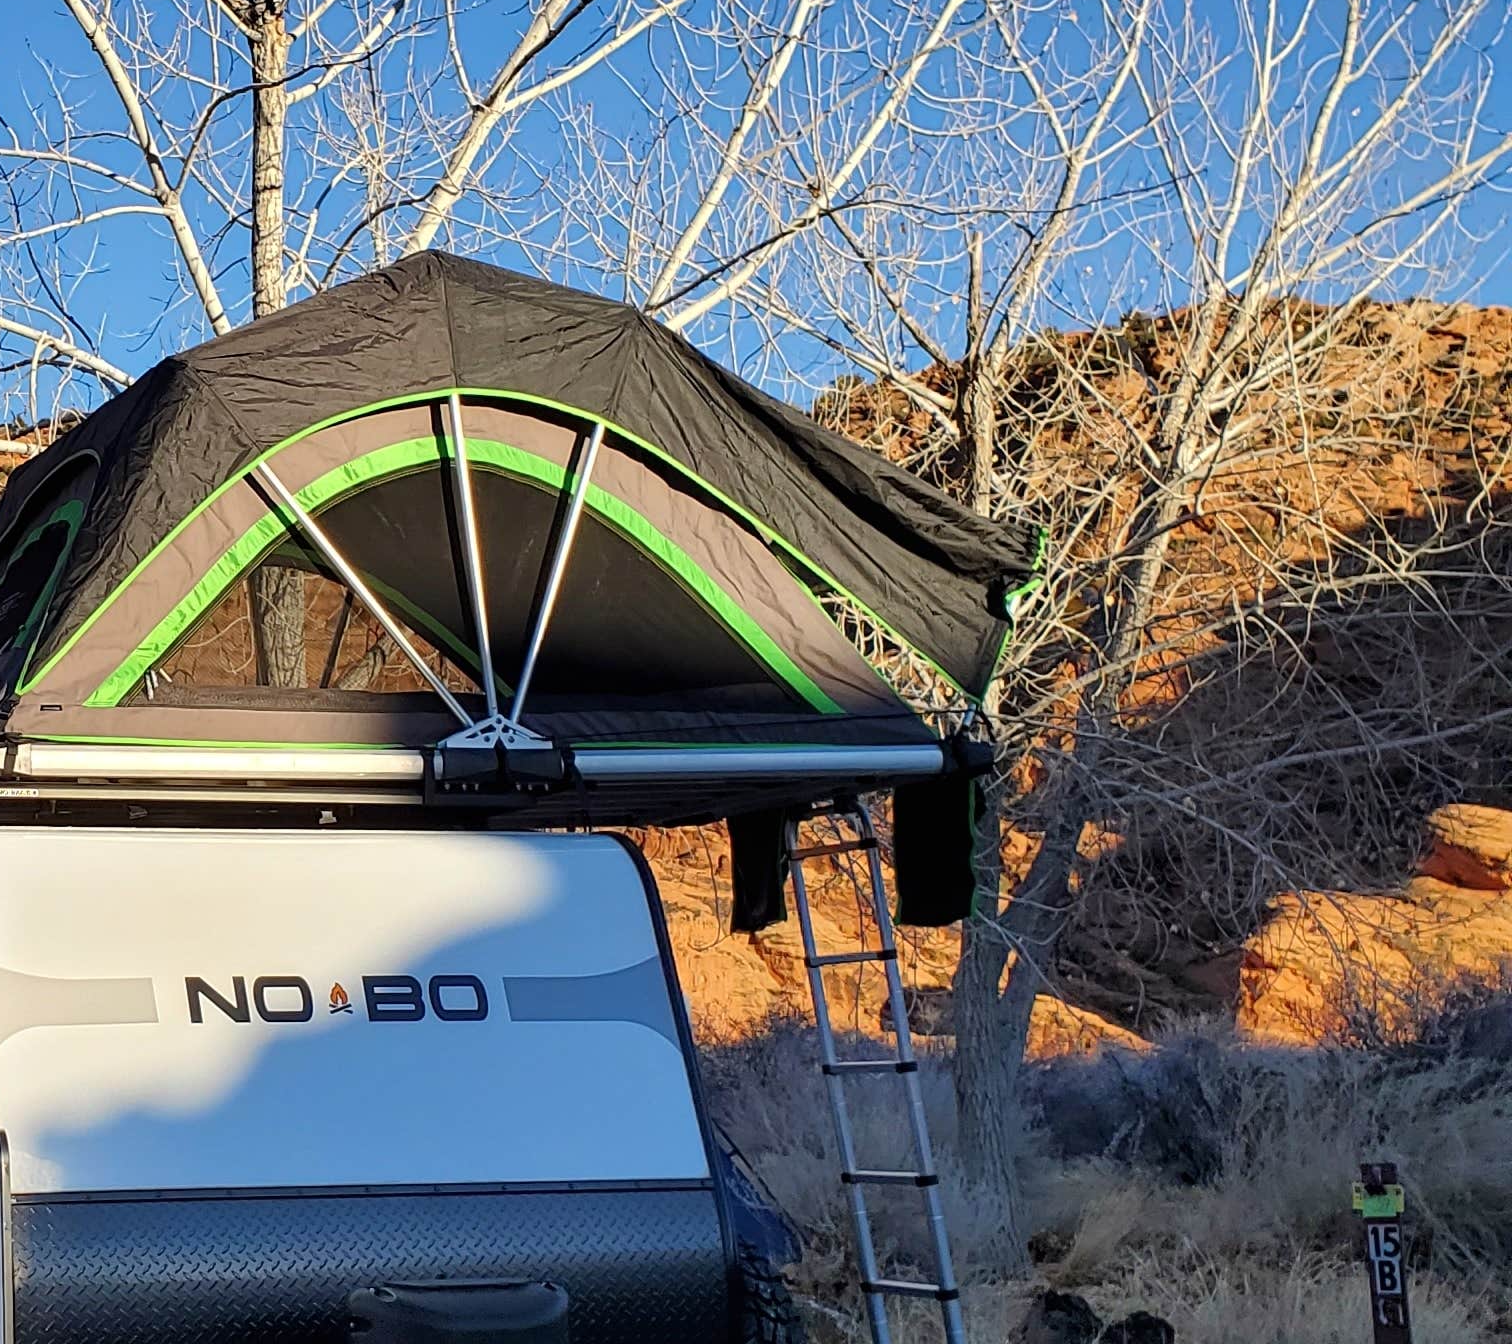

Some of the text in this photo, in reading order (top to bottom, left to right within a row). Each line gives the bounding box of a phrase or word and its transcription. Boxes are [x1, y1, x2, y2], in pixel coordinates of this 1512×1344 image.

[185, 974, 489, 1023] NO BO
[1370, 1226, 1400, 1258] 15
[1378, 1260, 1398, 1291] B
